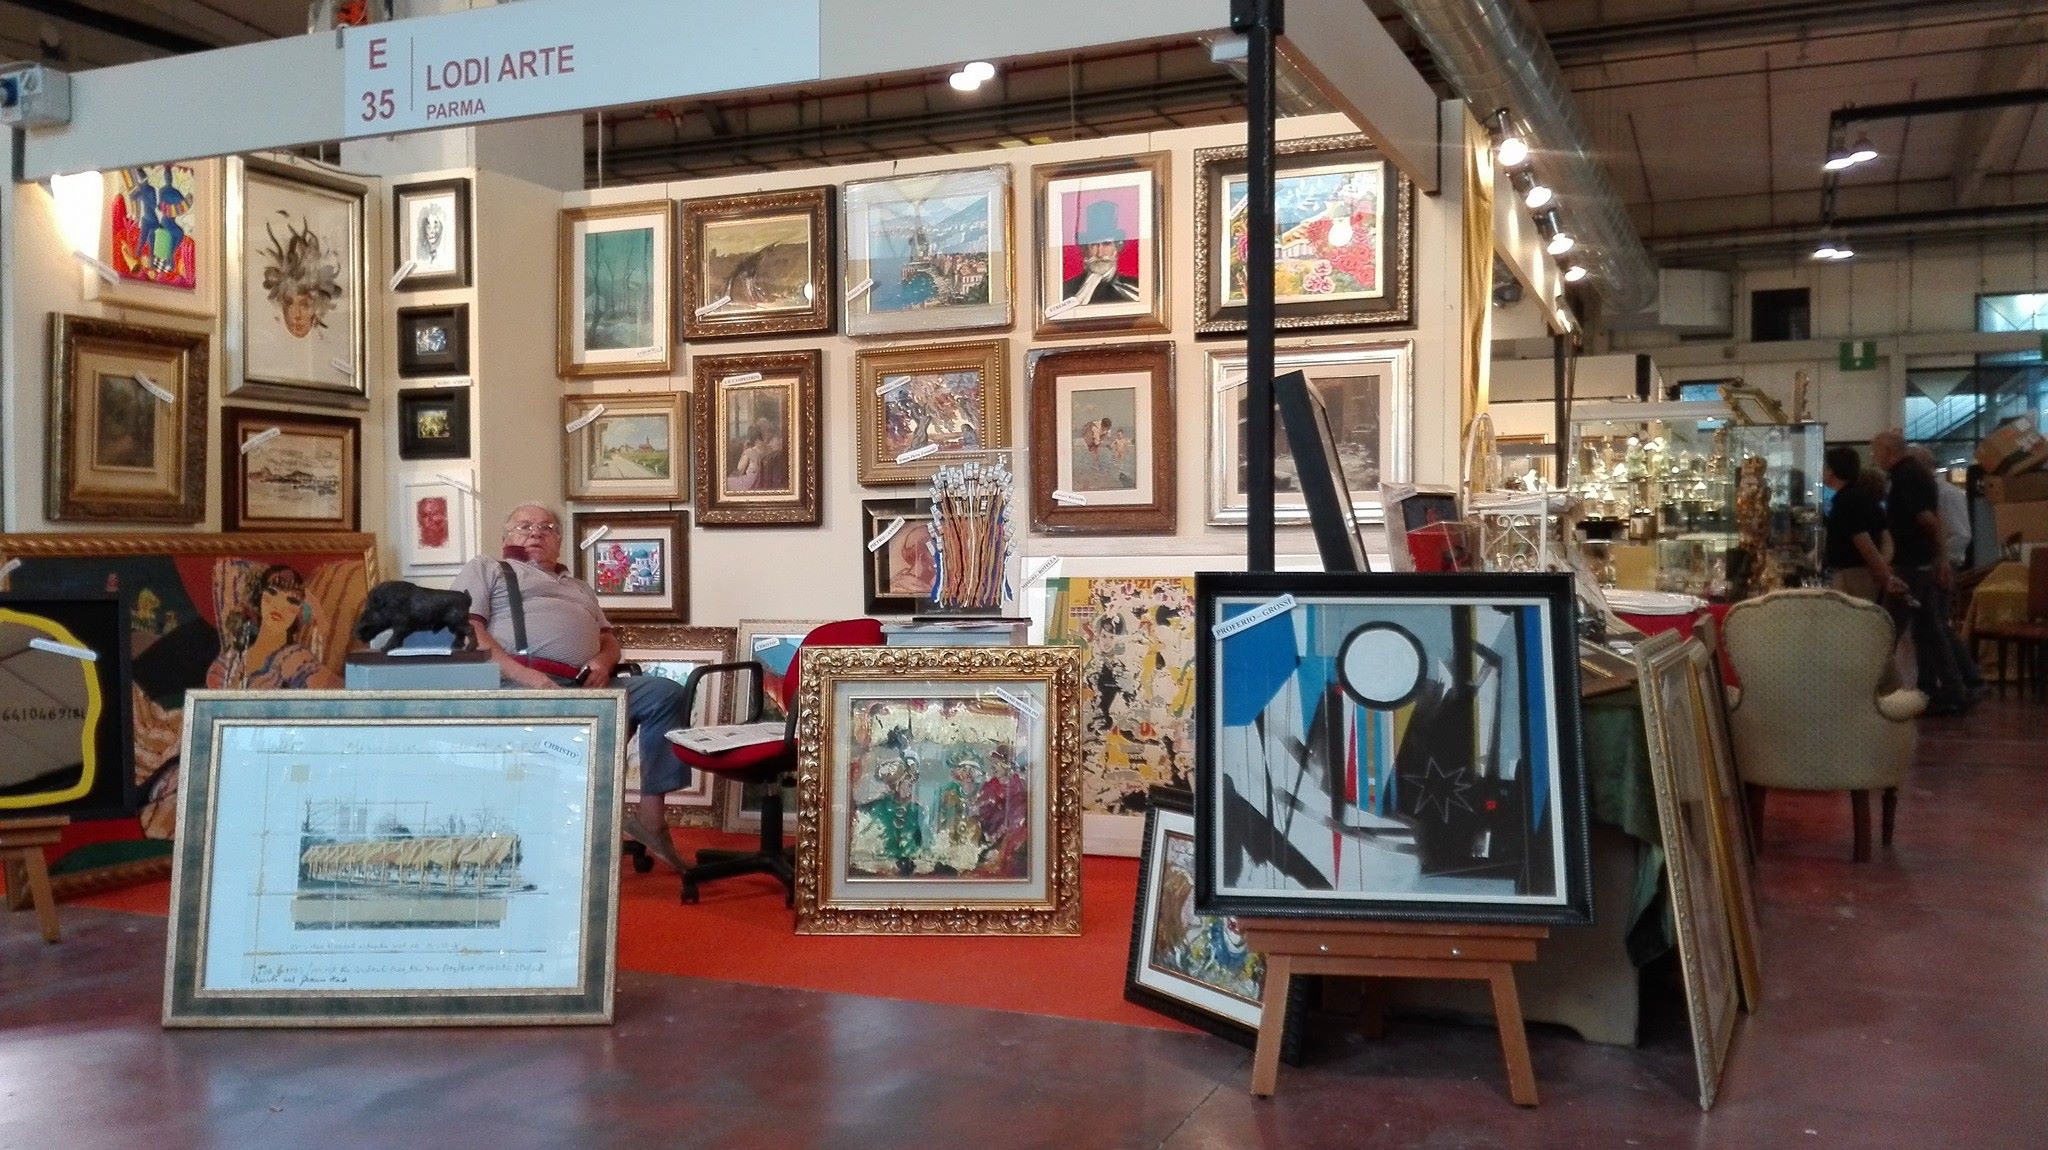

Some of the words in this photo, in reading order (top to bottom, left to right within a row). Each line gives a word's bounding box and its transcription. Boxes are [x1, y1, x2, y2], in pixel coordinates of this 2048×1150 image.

[368, 37, 388, 70] E
[426, 56, 490, 91] LODI
[497, 44, 575, 82] ARTE
[361, 88, 395, 122] 35
[426, 98, 486, 121] PARMA
[1215, 615, 1257, 637] PROFERIO
[1262, 598, 1293, 617] GROSSI
